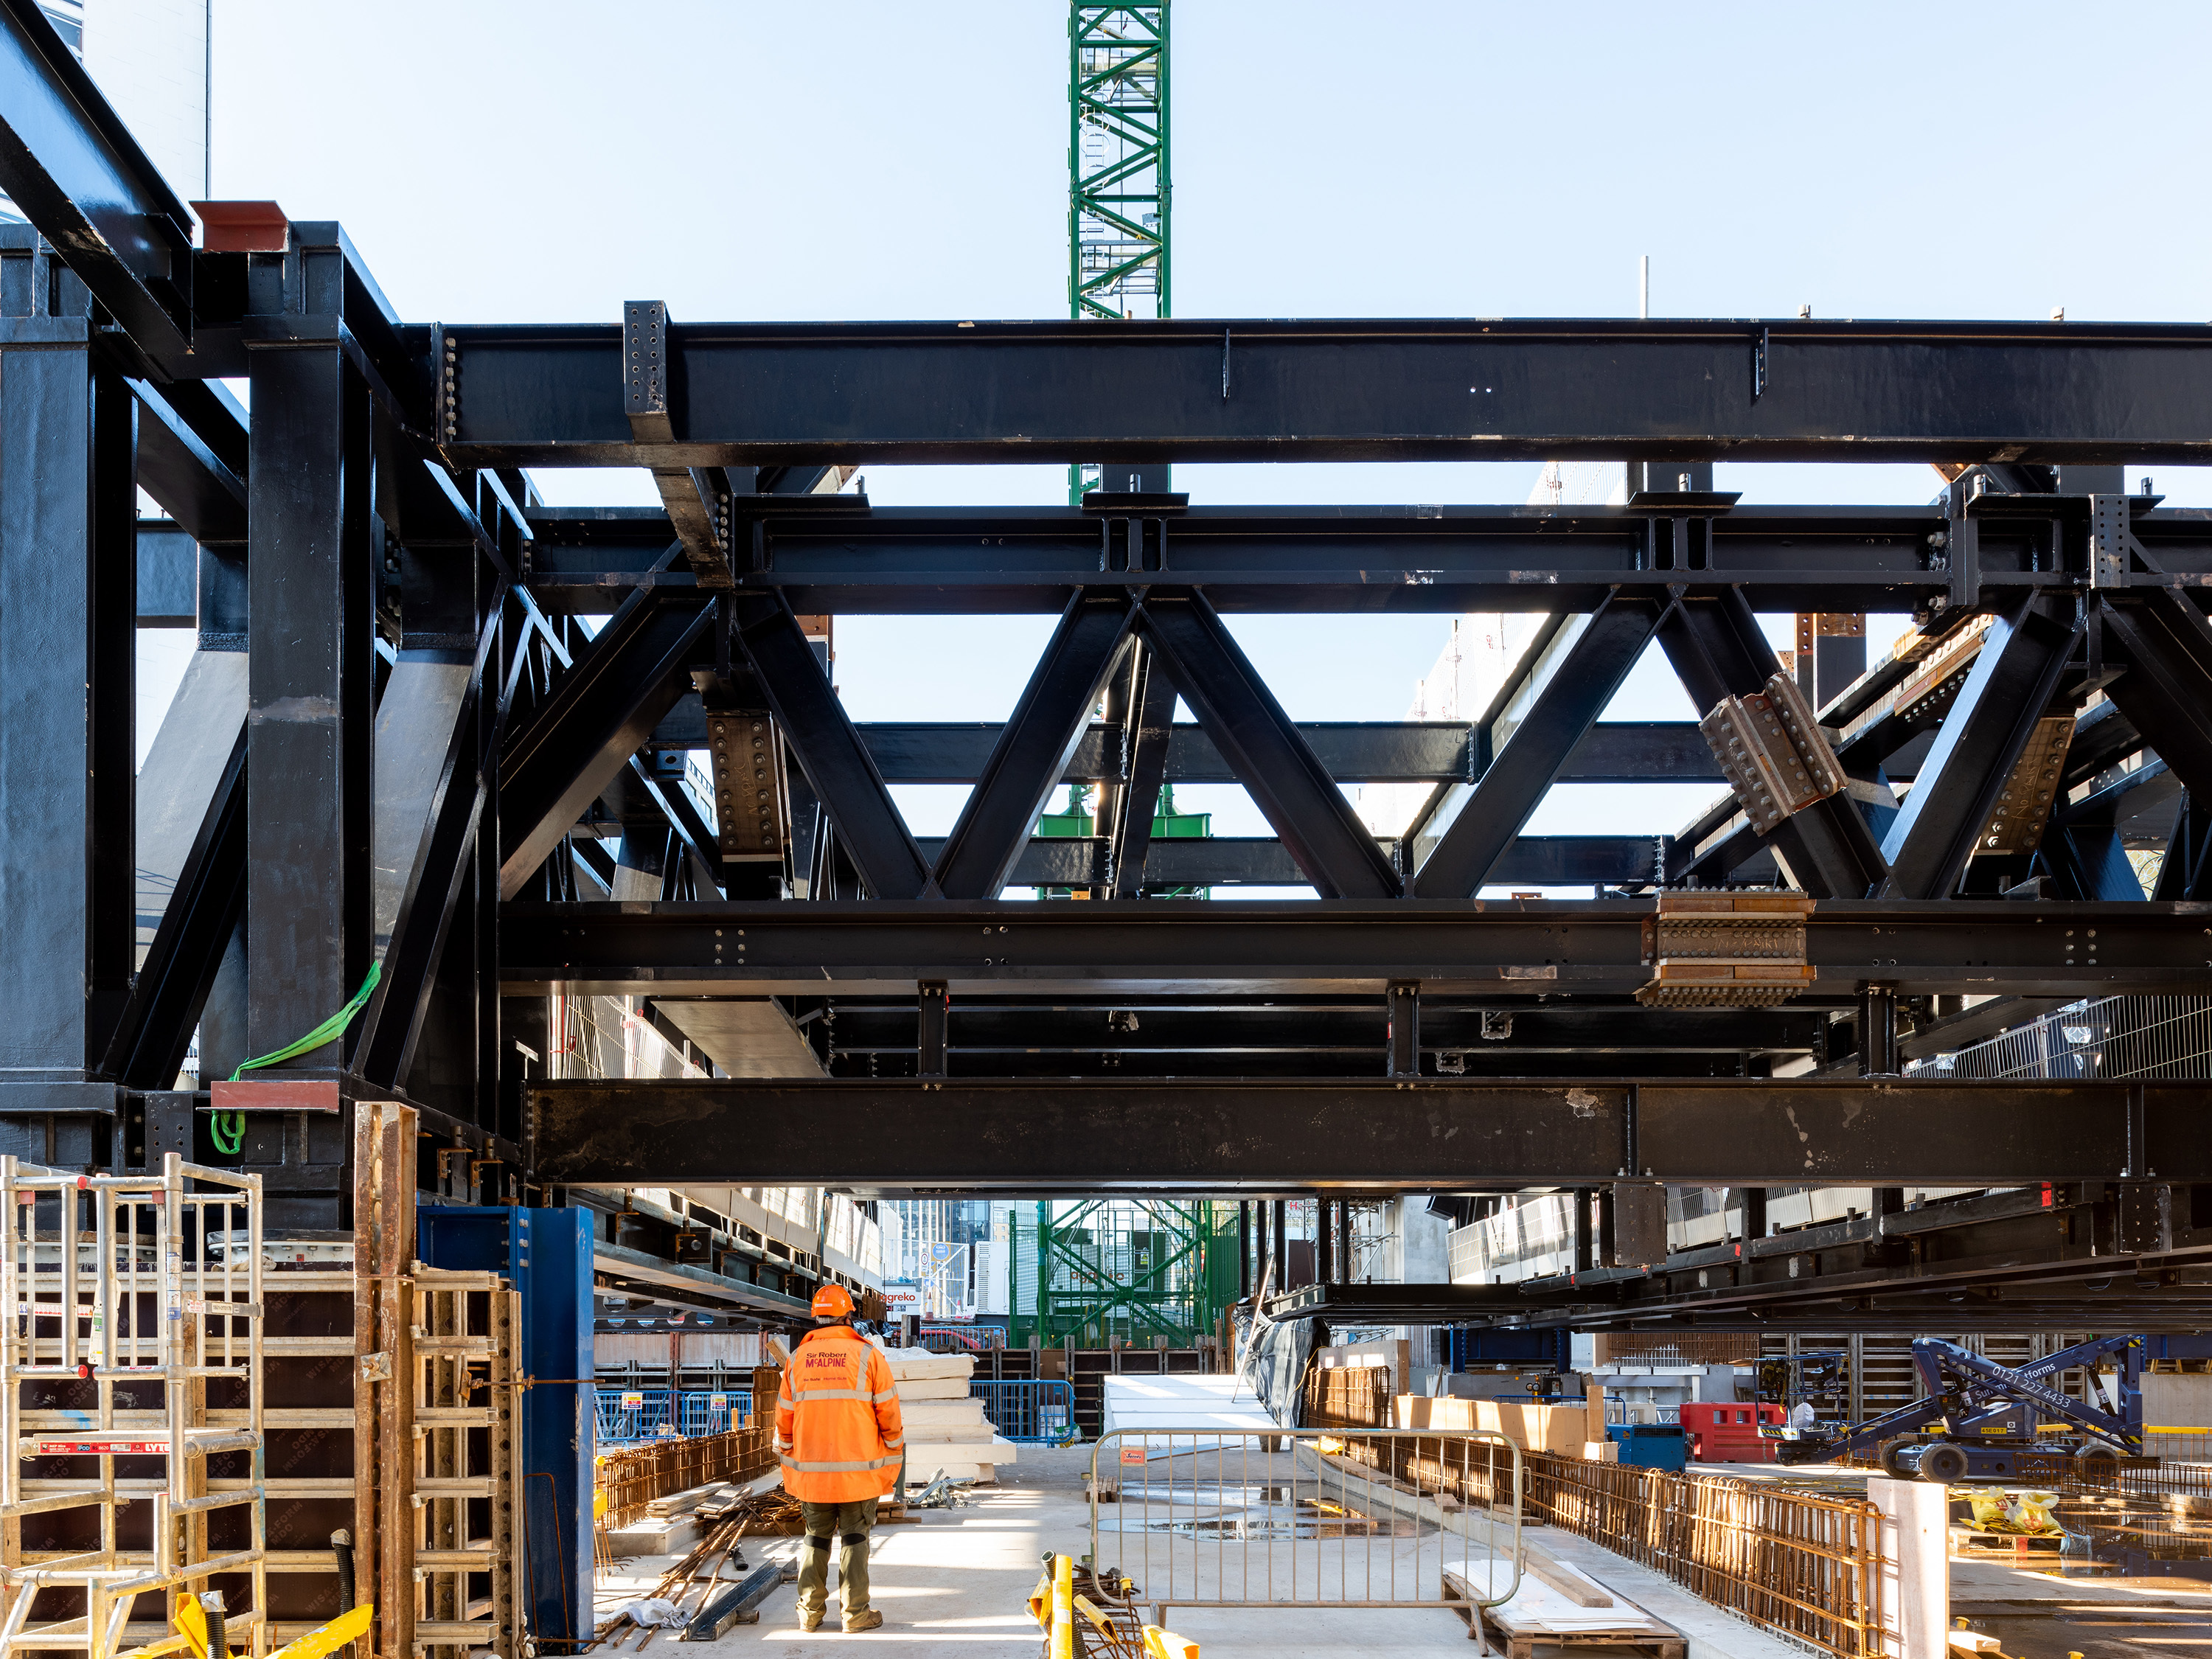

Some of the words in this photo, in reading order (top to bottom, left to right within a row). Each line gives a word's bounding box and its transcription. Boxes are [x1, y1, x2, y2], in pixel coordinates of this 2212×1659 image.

[880, 1292, 916, 1304] ggreko
[2023, 1363, 2056, 1379] tforms
[1992, 1366, 2020, 1385] 0121
[2020, 1379, 2043, 1394] 227
[2043, 1390, 2071, 1409] 4433
